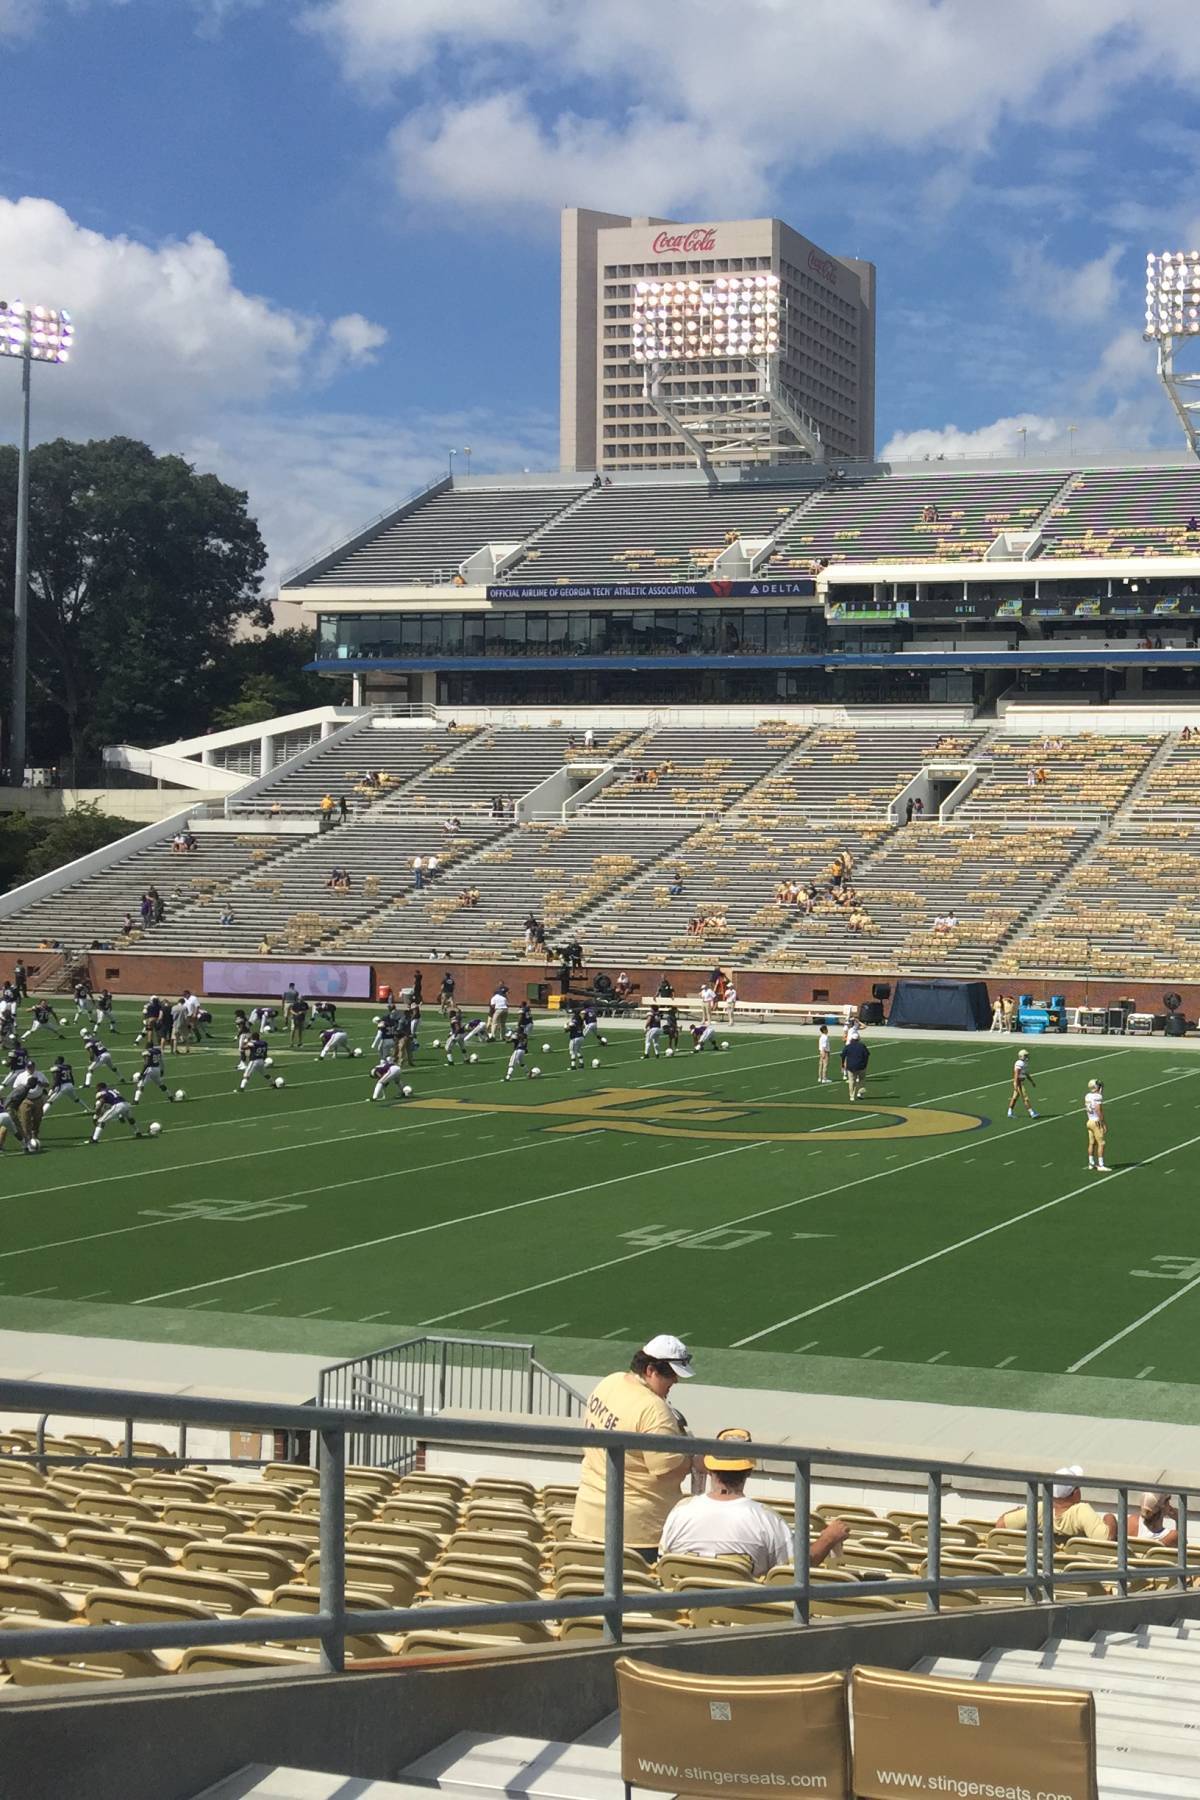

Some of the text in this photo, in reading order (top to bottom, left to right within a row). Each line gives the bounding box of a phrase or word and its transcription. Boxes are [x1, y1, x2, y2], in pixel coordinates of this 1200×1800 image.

[652, 227, 720, 254] Coca-Cola
[490, 589, 520, 598] OFFICIAL
[521, 588, 548, 597] AIRLINE
[549, 588, 558, 597] OF
[560, 587, 591, 597] GEORGIA
[614, 586, 647, 596] ATHLETIC
[762, 583, 801, 593] DELTA
[615, 1223, 774, 1251] 40
[638, 1756, 828, 1789] www.stingerseats.com
[876, 1768, 1073, 1800] www.stingerseats.com
